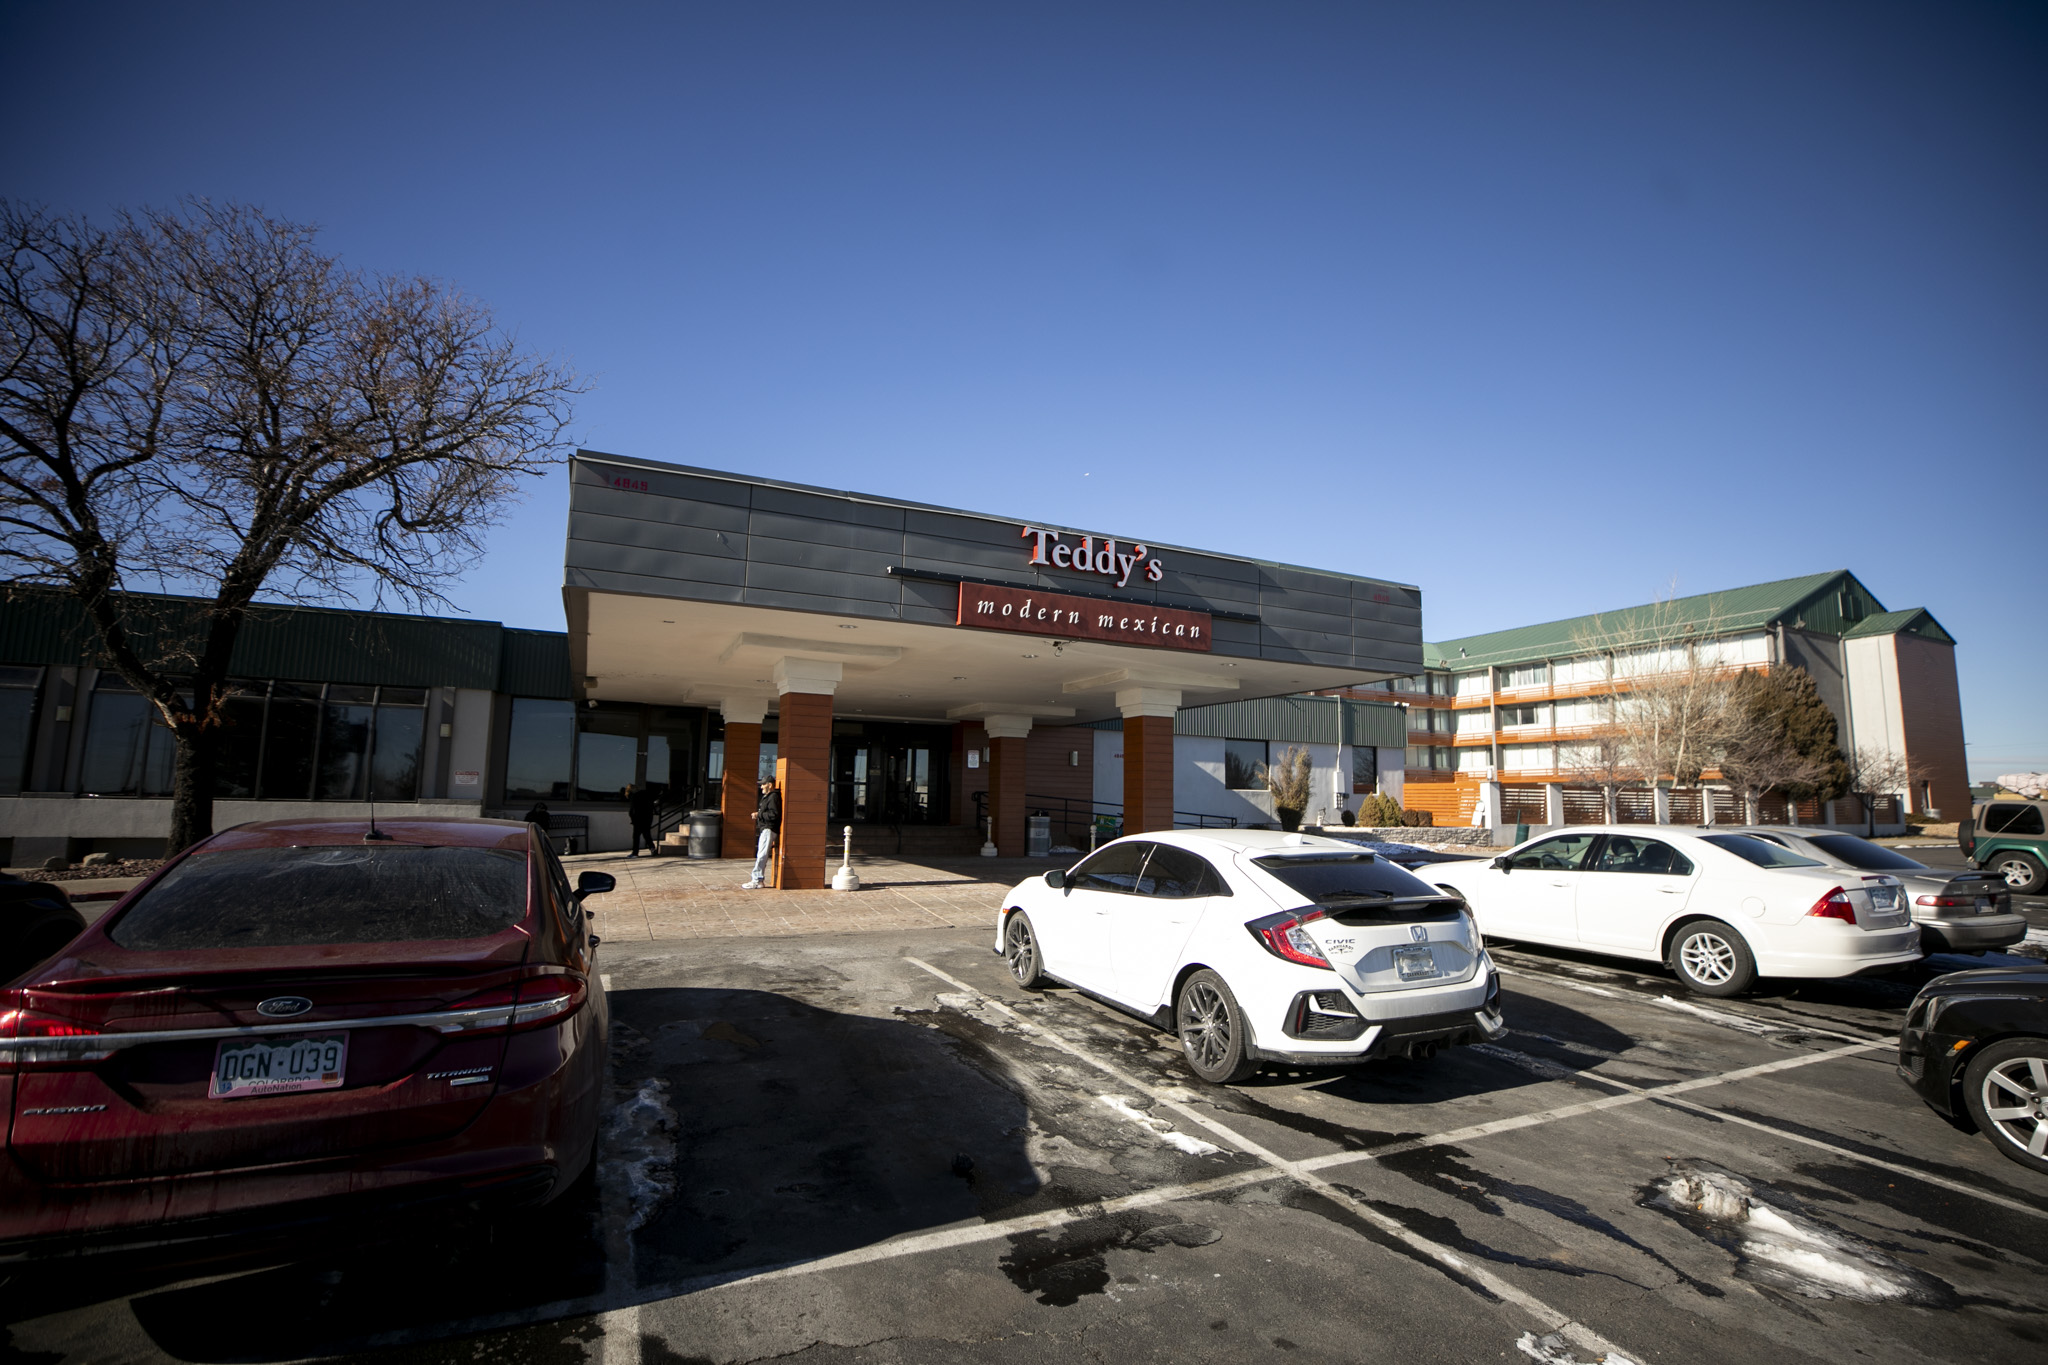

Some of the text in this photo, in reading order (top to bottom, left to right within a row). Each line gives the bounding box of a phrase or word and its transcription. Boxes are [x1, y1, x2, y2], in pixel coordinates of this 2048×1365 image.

[1021, 525, 1163, 588] Teddy's
[977, 599, 1201, 638] modern mexican
[268, 1001, 301, 1013] Ford
[426, 1066, 494, 1080] TITANIUM
[250, 1082, 303, 1094] AutoNation
